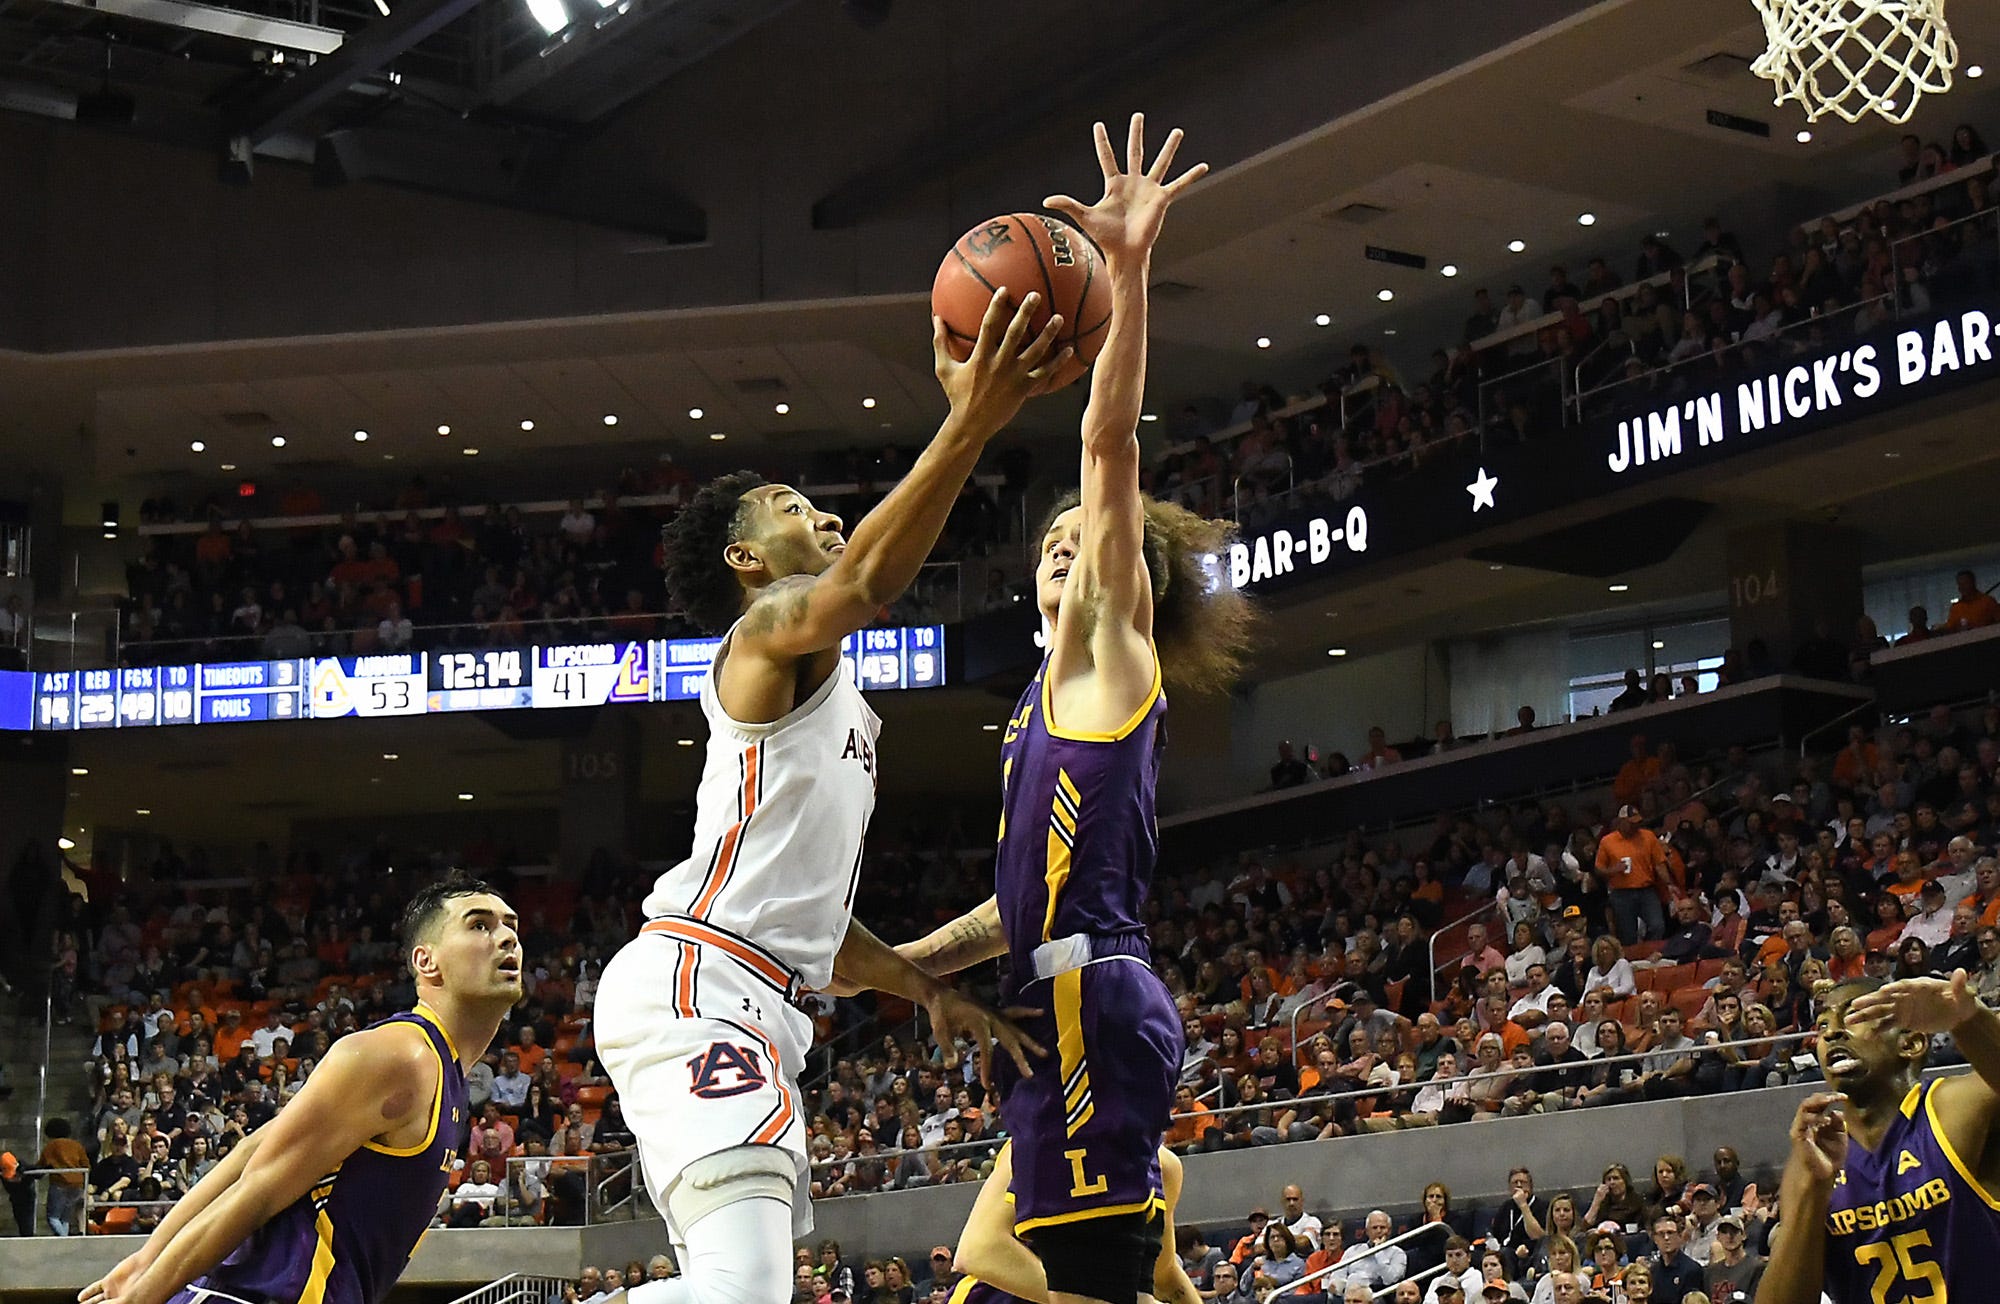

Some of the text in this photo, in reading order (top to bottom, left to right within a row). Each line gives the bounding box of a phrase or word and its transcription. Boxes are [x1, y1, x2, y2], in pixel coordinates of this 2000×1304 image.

[1738, 345, 1881, 434] NICK'S
[1230, 506, 1368, 588] BAR-B-Q
[1733, 569, 1778, 608] 104
[866, 630, 897, 650] FG%
[914, 628, 934, 647] TO
[43, 673, 70, 692] AST
[85, 671, 111, 690] REB
[169, 666, 187, 685] TO
[203, 662, 293, 687] TIMEOUTS 3
[438, 651, 522, 689] 12:14
[861, 655, 899, 683] 43
[914, 653, 934, 681] 9
[371, 681, 410, 709] 53
[552, 671, 587, 699] 41
[40, 691, 192, 725] 14 25 49 10
[212, 692, 293, 718] FOULS 2
[1064, 1148, 1109, 1198] L
[1854, 1228, 1949, 1304] 25
